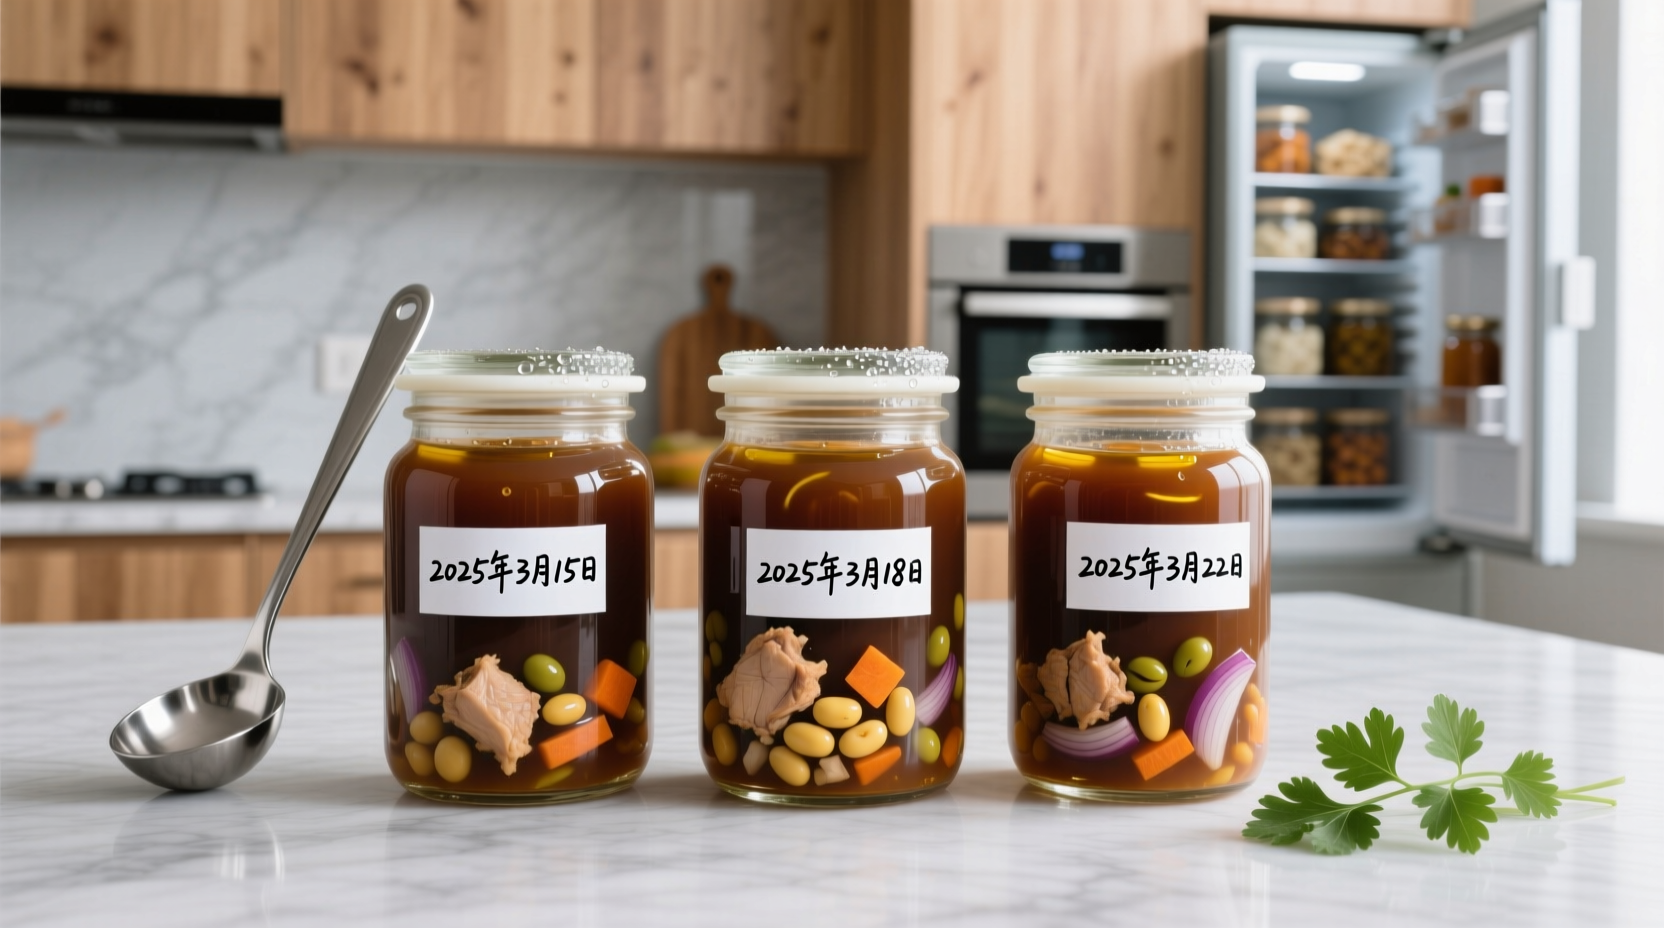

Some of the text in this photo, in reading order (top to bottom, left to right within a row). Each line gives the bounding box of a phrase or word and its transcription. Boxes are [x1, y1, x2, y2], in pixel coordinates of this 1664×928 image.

[429, 549, 597, 594] 2025年3月15日
[756, 551, 922, 596] 2025年3月18日
[1077, 546, 1242, 590] 2025年3月22日
